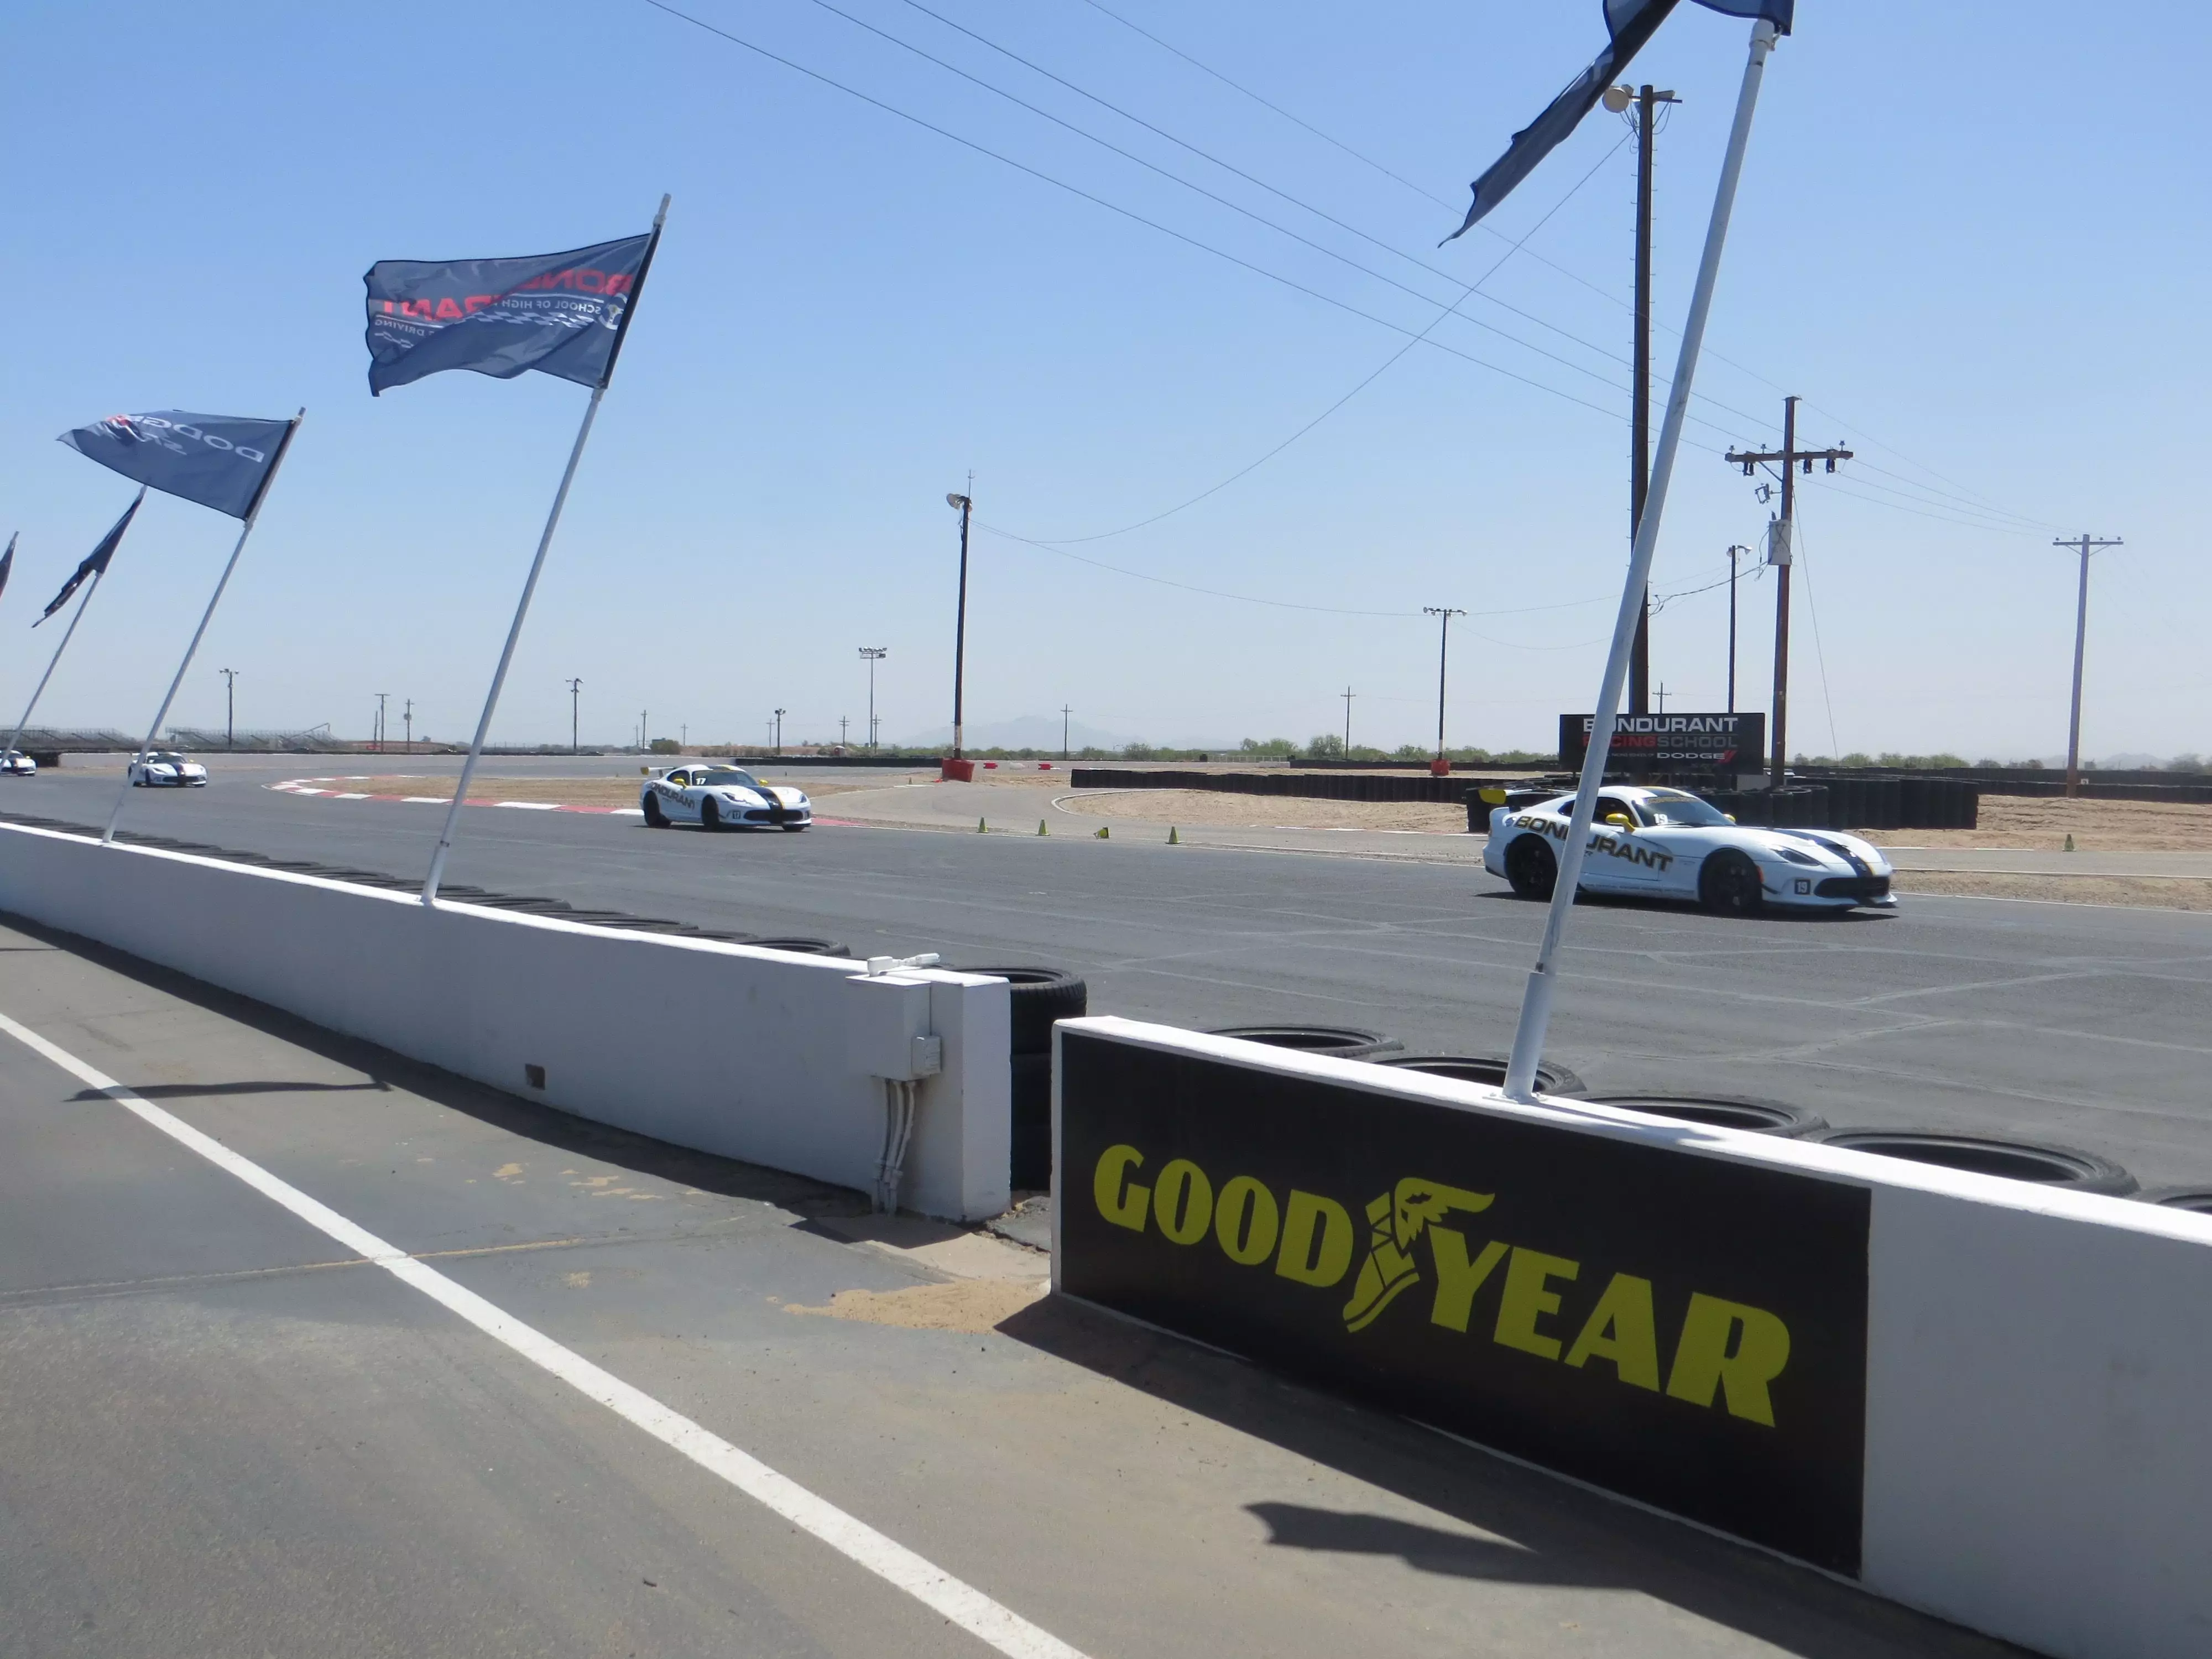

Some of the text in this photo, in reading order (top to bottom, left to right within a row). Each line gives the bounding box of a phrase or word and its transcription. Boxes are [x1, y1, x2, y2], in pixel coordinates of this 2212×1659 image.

[1584, 718, 1738, 732] BNDURANT
[1653, 813, 1668, 824] 19
[1514, 816, 1673, 872] BONURANT
